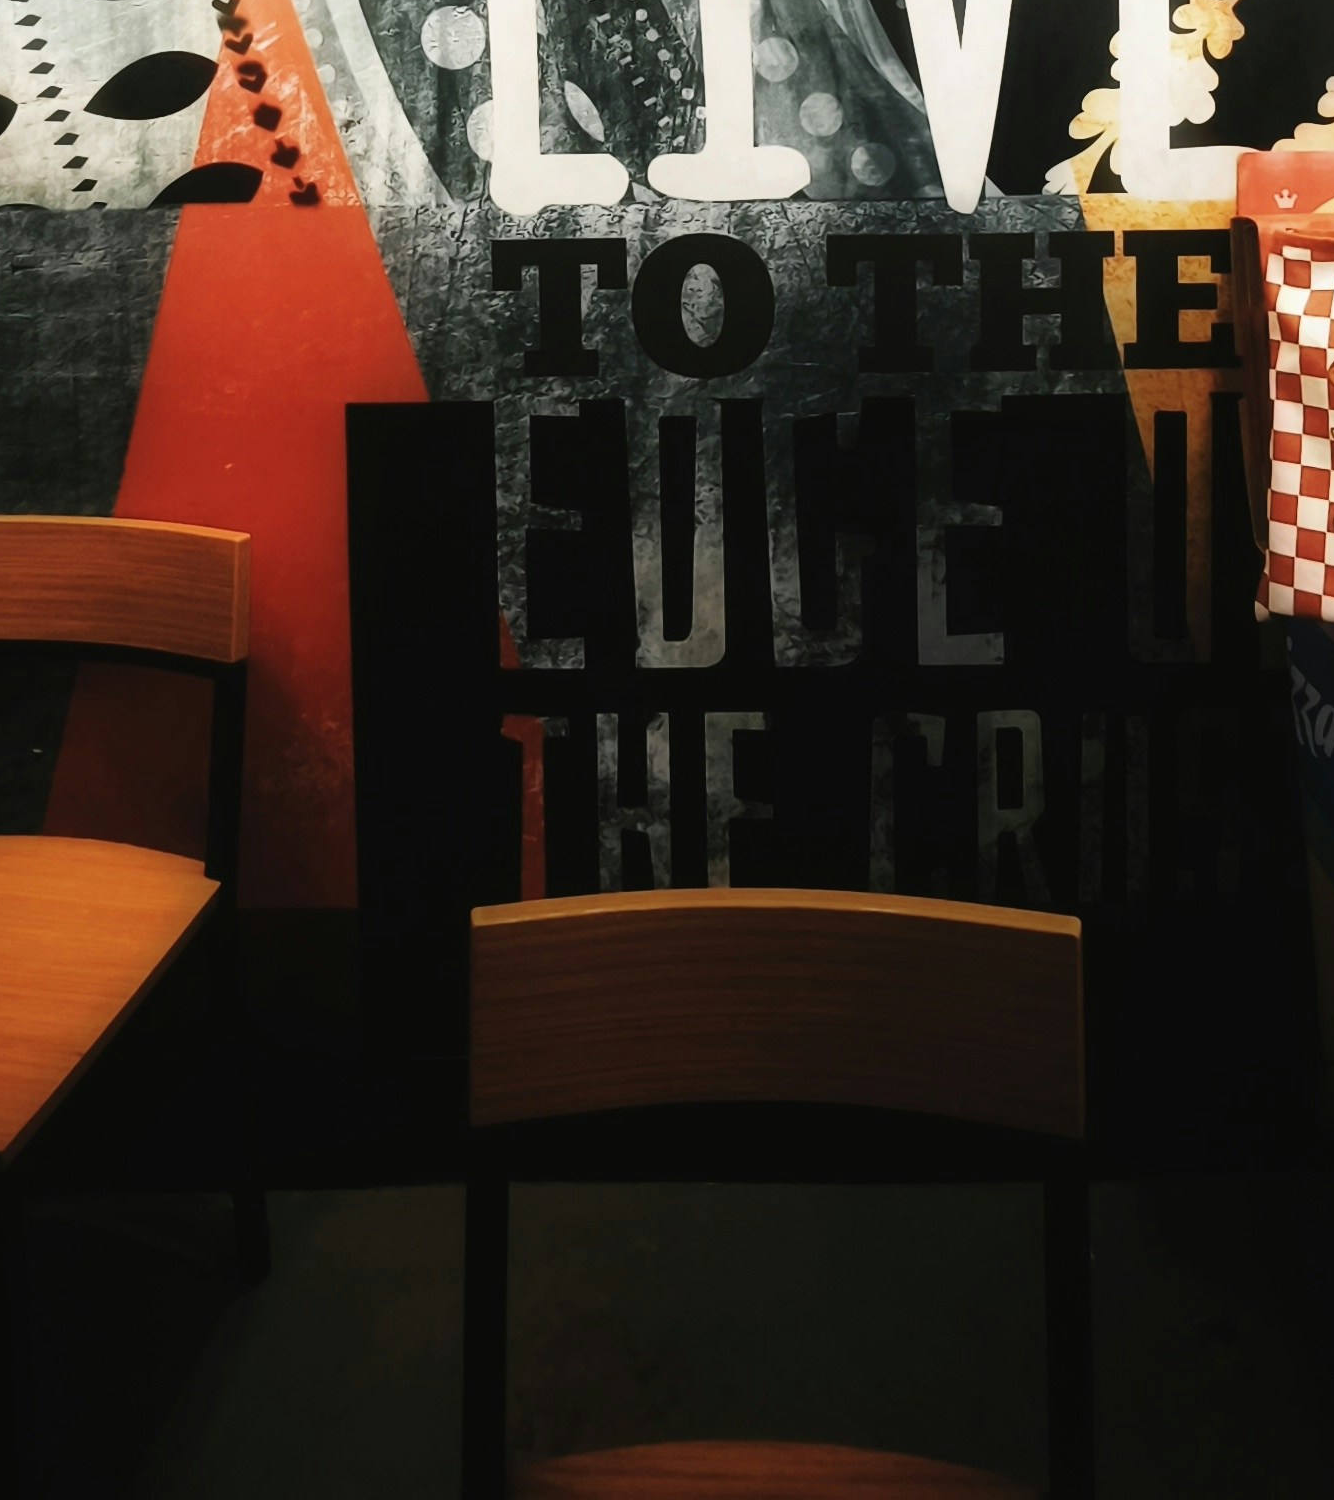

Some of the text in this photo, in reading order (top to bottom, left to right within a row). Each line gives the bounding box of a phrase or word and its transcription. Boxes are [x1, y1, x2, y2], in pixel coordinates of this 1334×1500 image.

[490, 229, 1245, 379] TO THE
[491, 396, 1005, 670] EDGE
